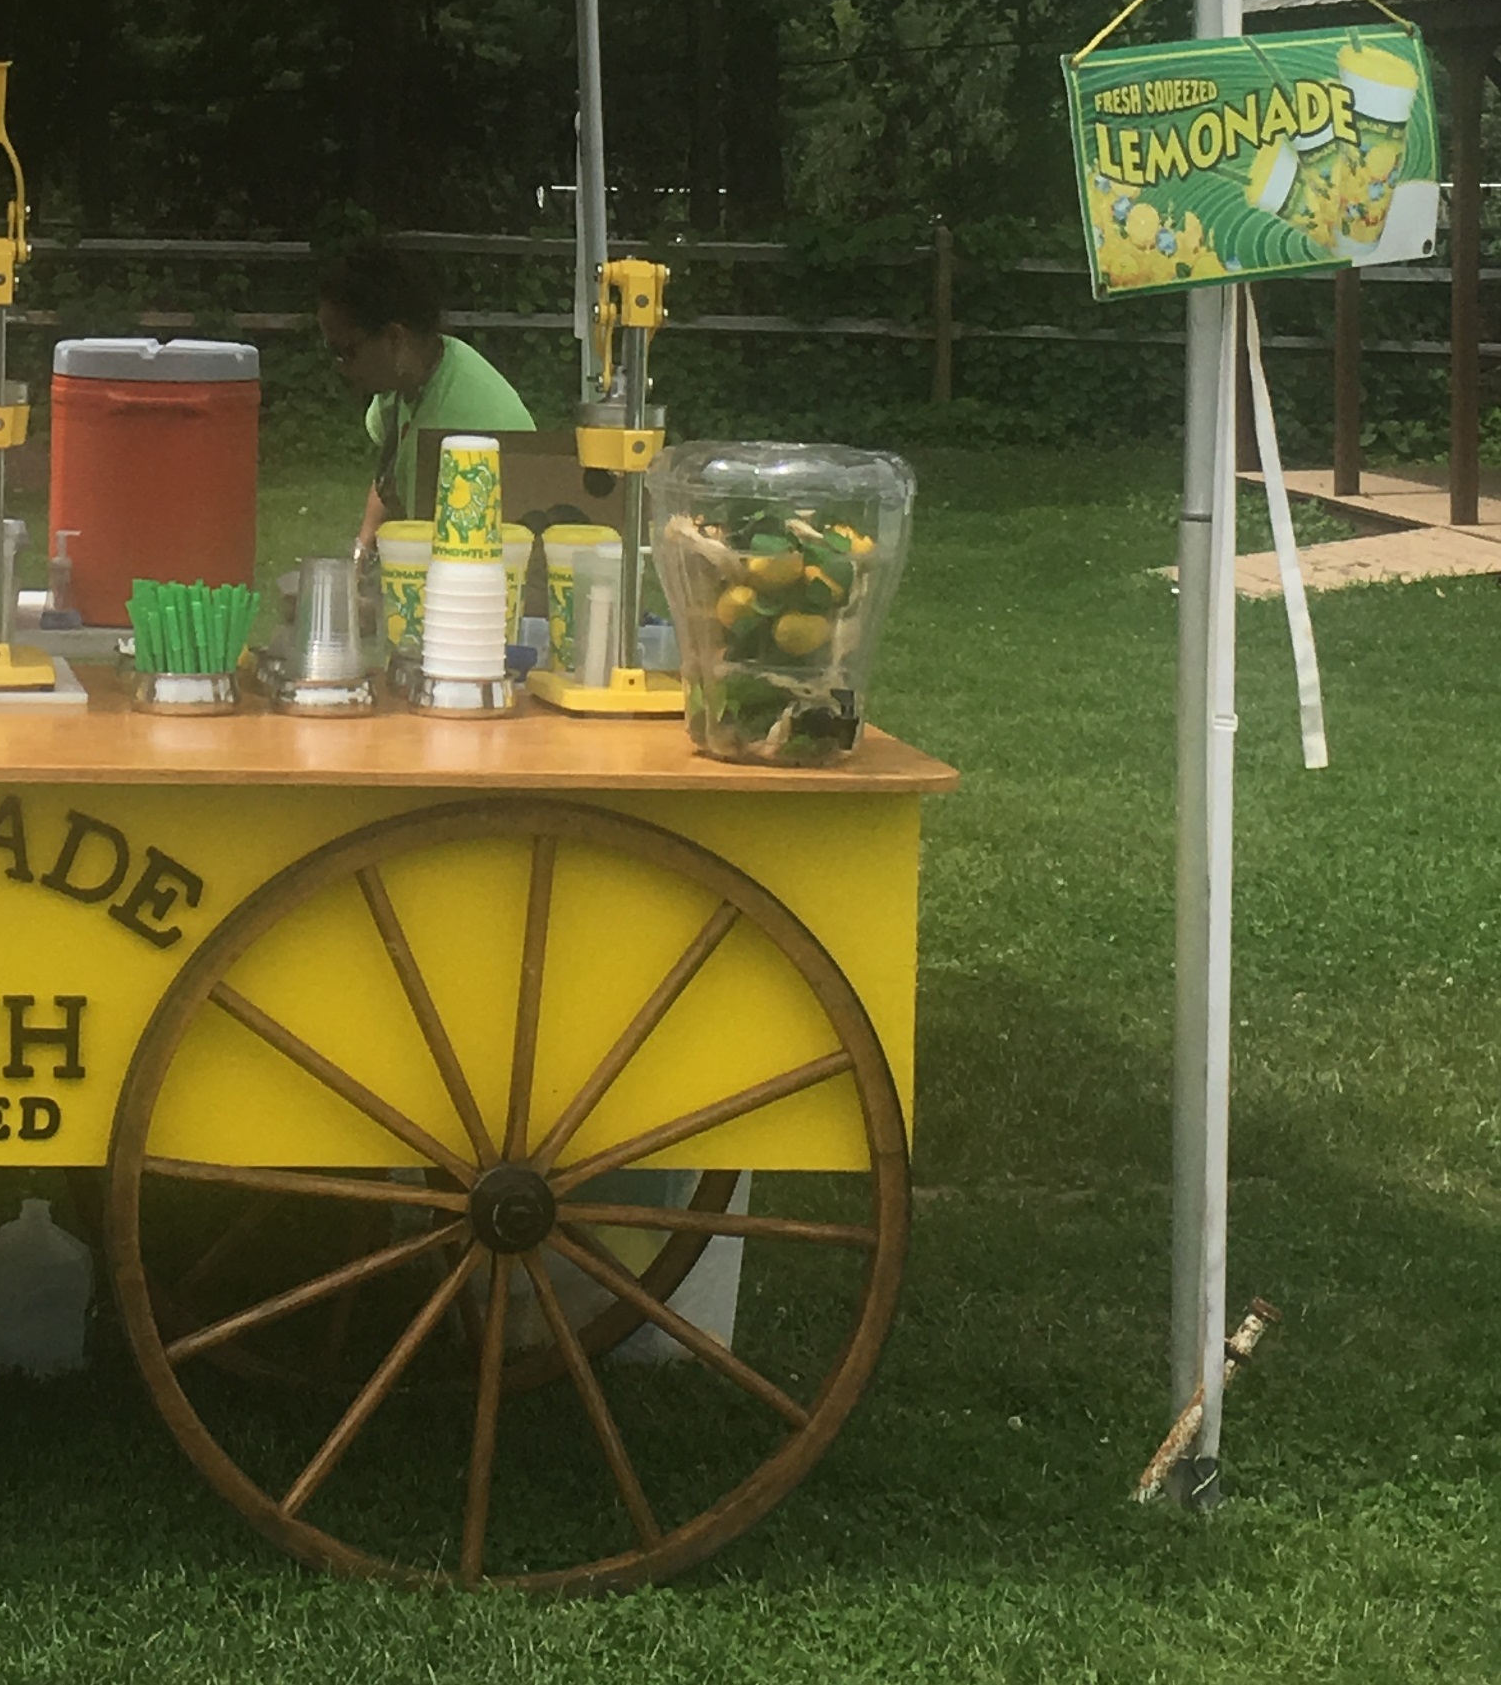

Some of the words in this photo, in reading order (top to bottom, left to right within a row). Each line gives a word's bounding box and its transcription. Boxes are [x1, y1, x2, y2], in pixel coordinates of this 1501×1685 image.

[1094, 89, 1141, 116] FRESH
[1145, 79, 1219, 114] SQUEEZED
[1094, 80, 1360, 186] LEMONADE
